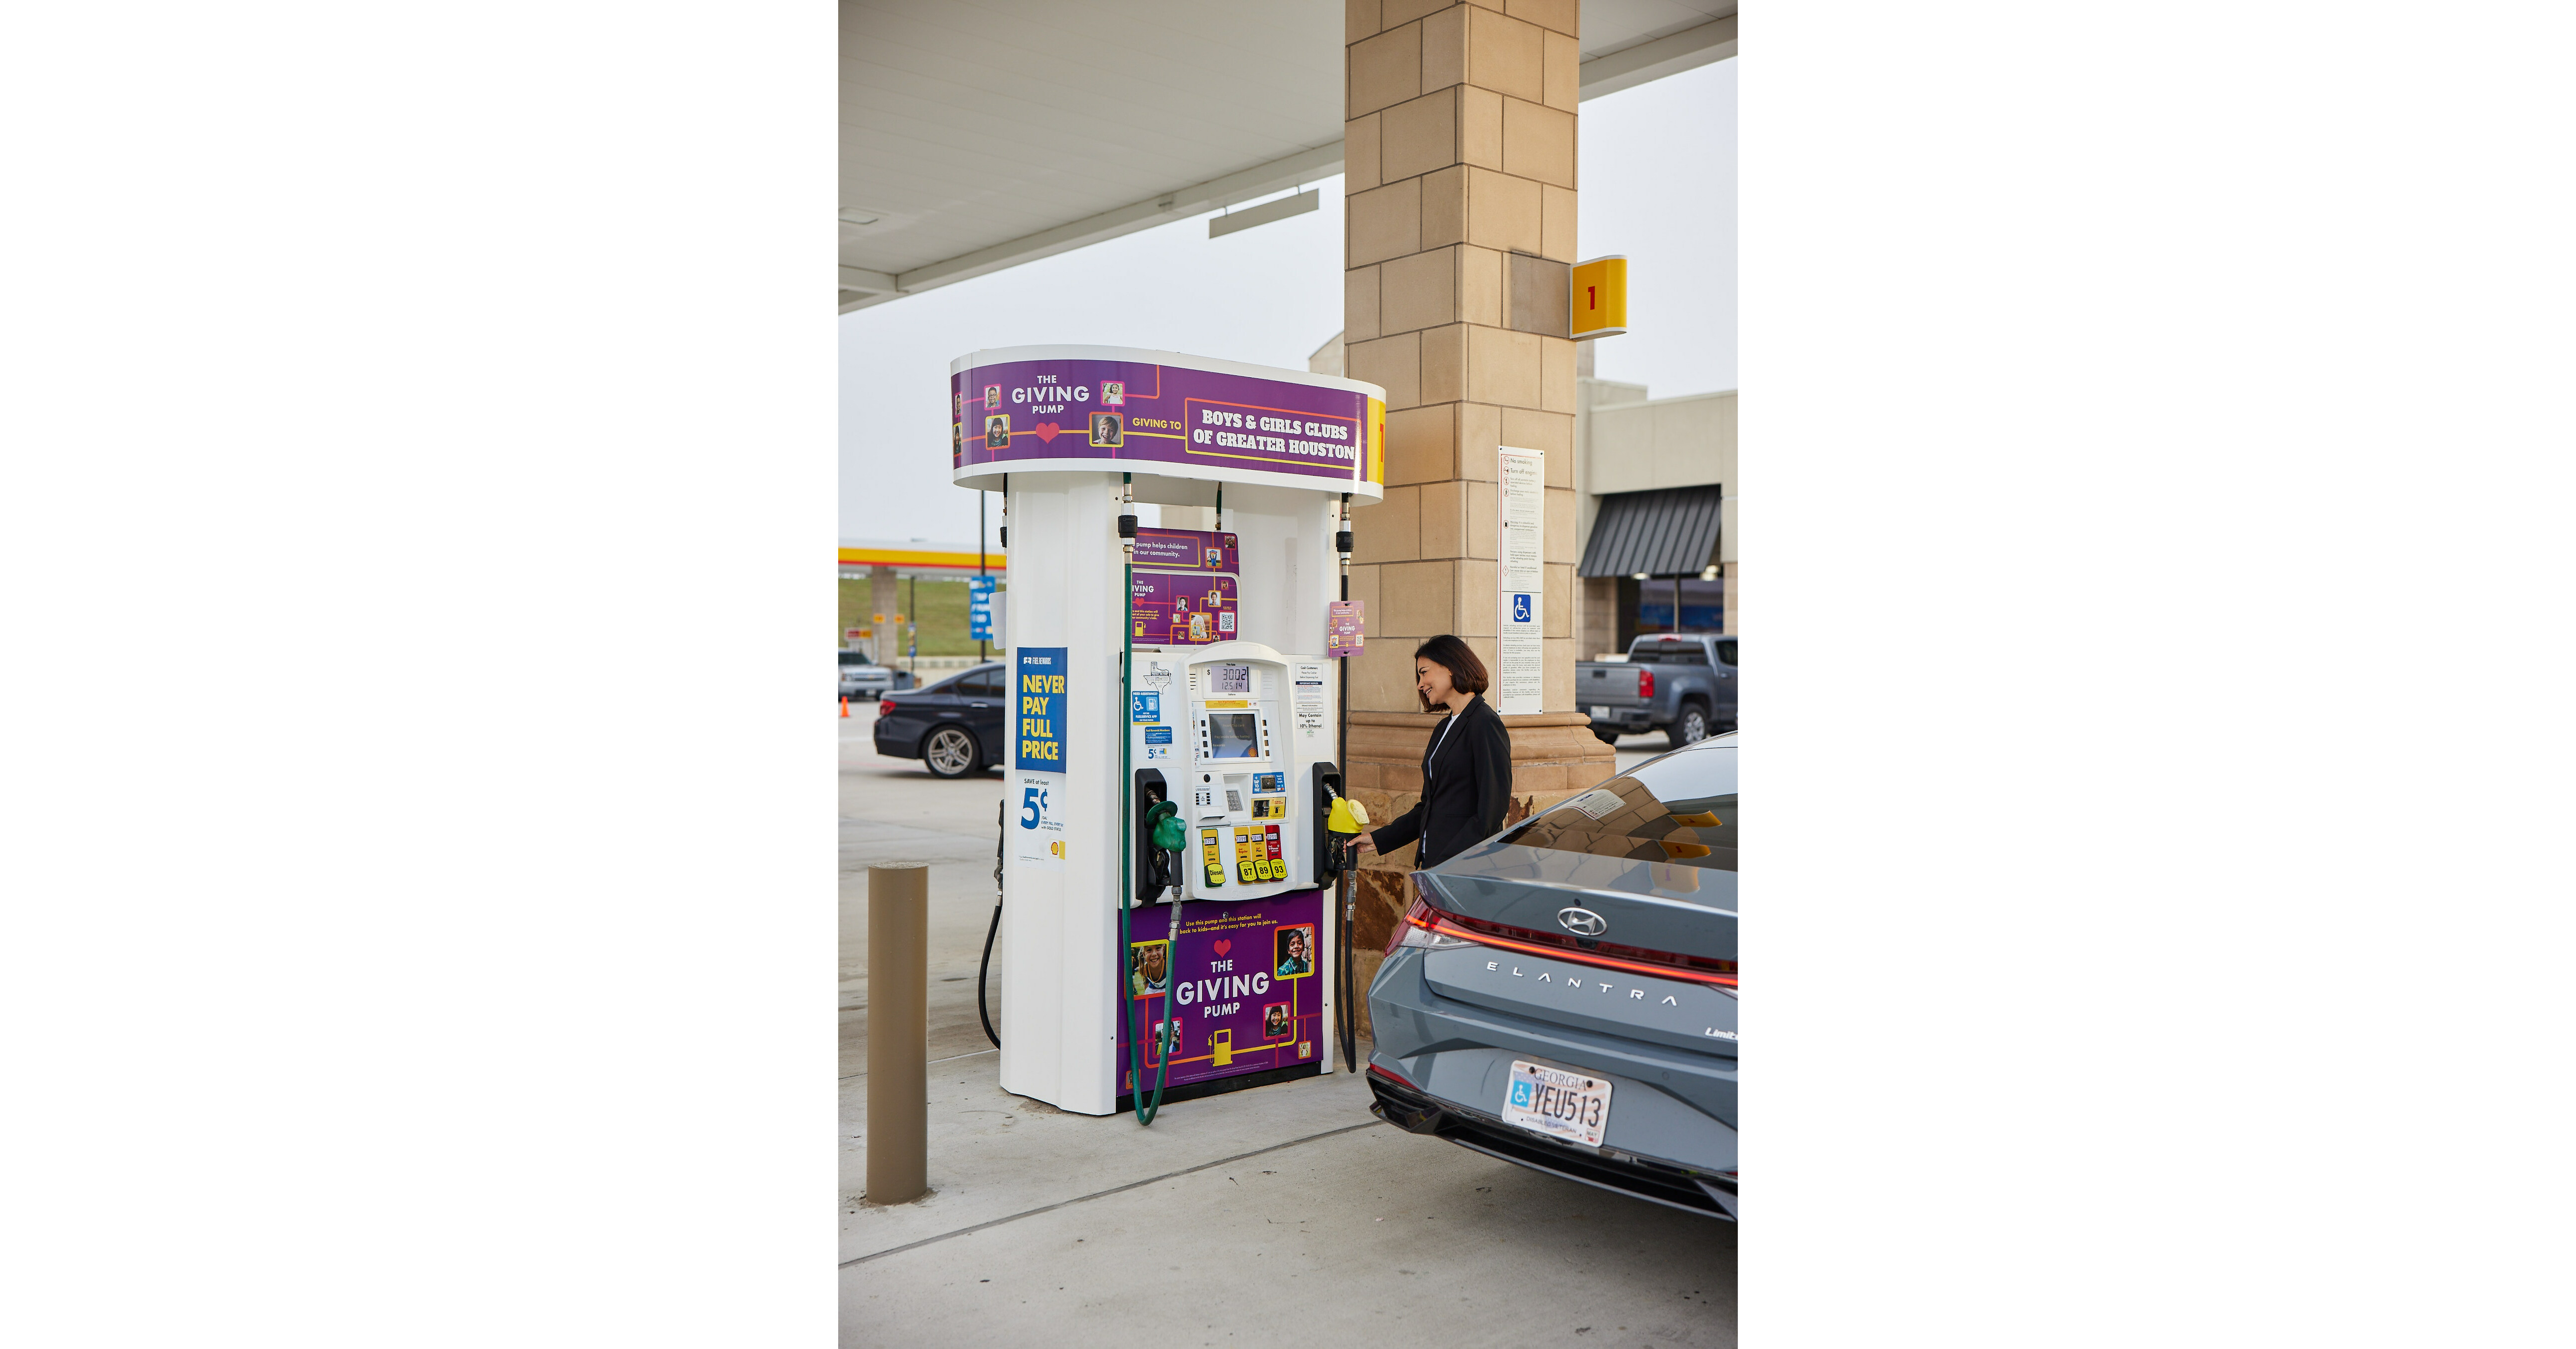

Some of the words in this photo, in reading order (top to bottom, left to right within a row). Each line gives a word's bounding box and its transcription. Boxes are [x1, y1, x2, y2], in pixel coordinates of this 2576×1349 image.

[1588, 286, 1595, 310] 1
[1037, 375, 1056, 384] THE
[1012, 386, 1089, 404] GIVING
[1032, 405, 1064, 414] PUMP
[1132, 418, 1167, 429] GIVING
[1170, 420, 1181, 430] TO
[1202, 409, 1242, 428] BOYS
[1245, 415, 1256, 429] &
[1260, 417, 1301, 435] GIRLS
[1305, 422, 1347, 440] CLUBS
[1193, 429, 1213, 444] OF
[1216, 432, 1286, 452] GREATER
[1289, 440, 1355, 460] HOUSTON
[1023, 674, 1064, 693] NEVER
[1023, 696, 1049, 715] PAY
[1023, 718, 1052, 737] FULL
[1023, 740, 1058, 760] PRICE
[1211, 959, 1233, 973] THE
[1176, 971, 1270, 1005] GIVING
[1487, 961, 1677, 1006] ELANTRA
[1204, 1002, 1240, 1018] PUMP
[1534, 1068, 1586, 1091] GEORGIA
[1534, 1083, 1601, 1127] YEU513
